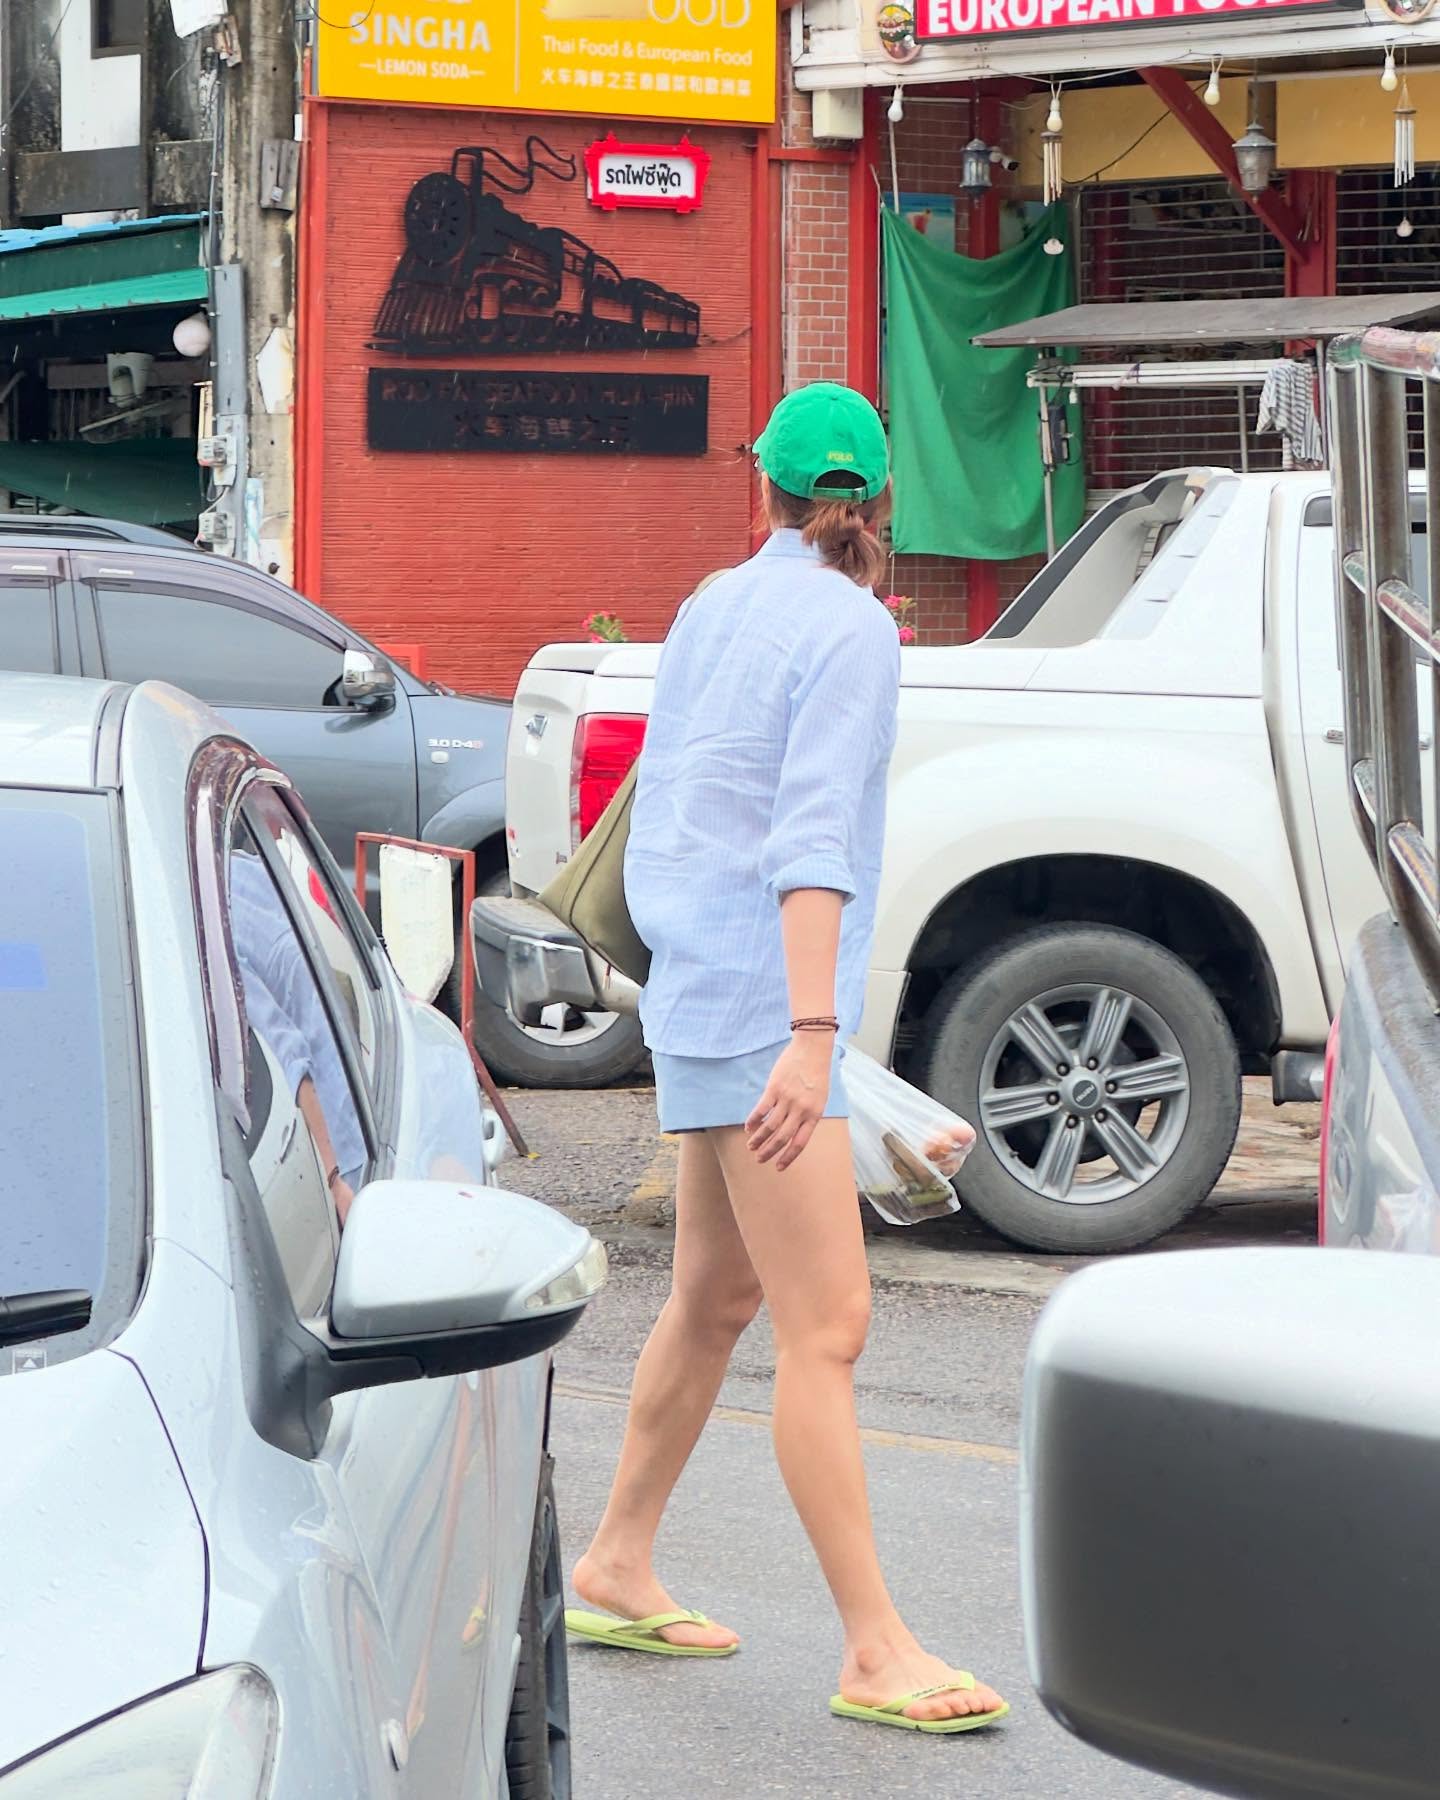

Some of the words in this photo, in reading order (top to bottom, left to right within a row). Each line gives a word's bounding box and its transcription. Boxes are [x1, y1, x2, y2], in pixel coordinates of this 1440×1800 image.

[349, 11, 492, 53] SINGHA
[543, 34, 575, 54] Thai
[579, 37, 619, 57] Food
[622, 40, 634, 58] &
[637, 41, 711, 66] European
[714, 47, 753, 66] Food
[376, 58, 426, 77] LEMON
[431, 61, 470, 79] SODA
